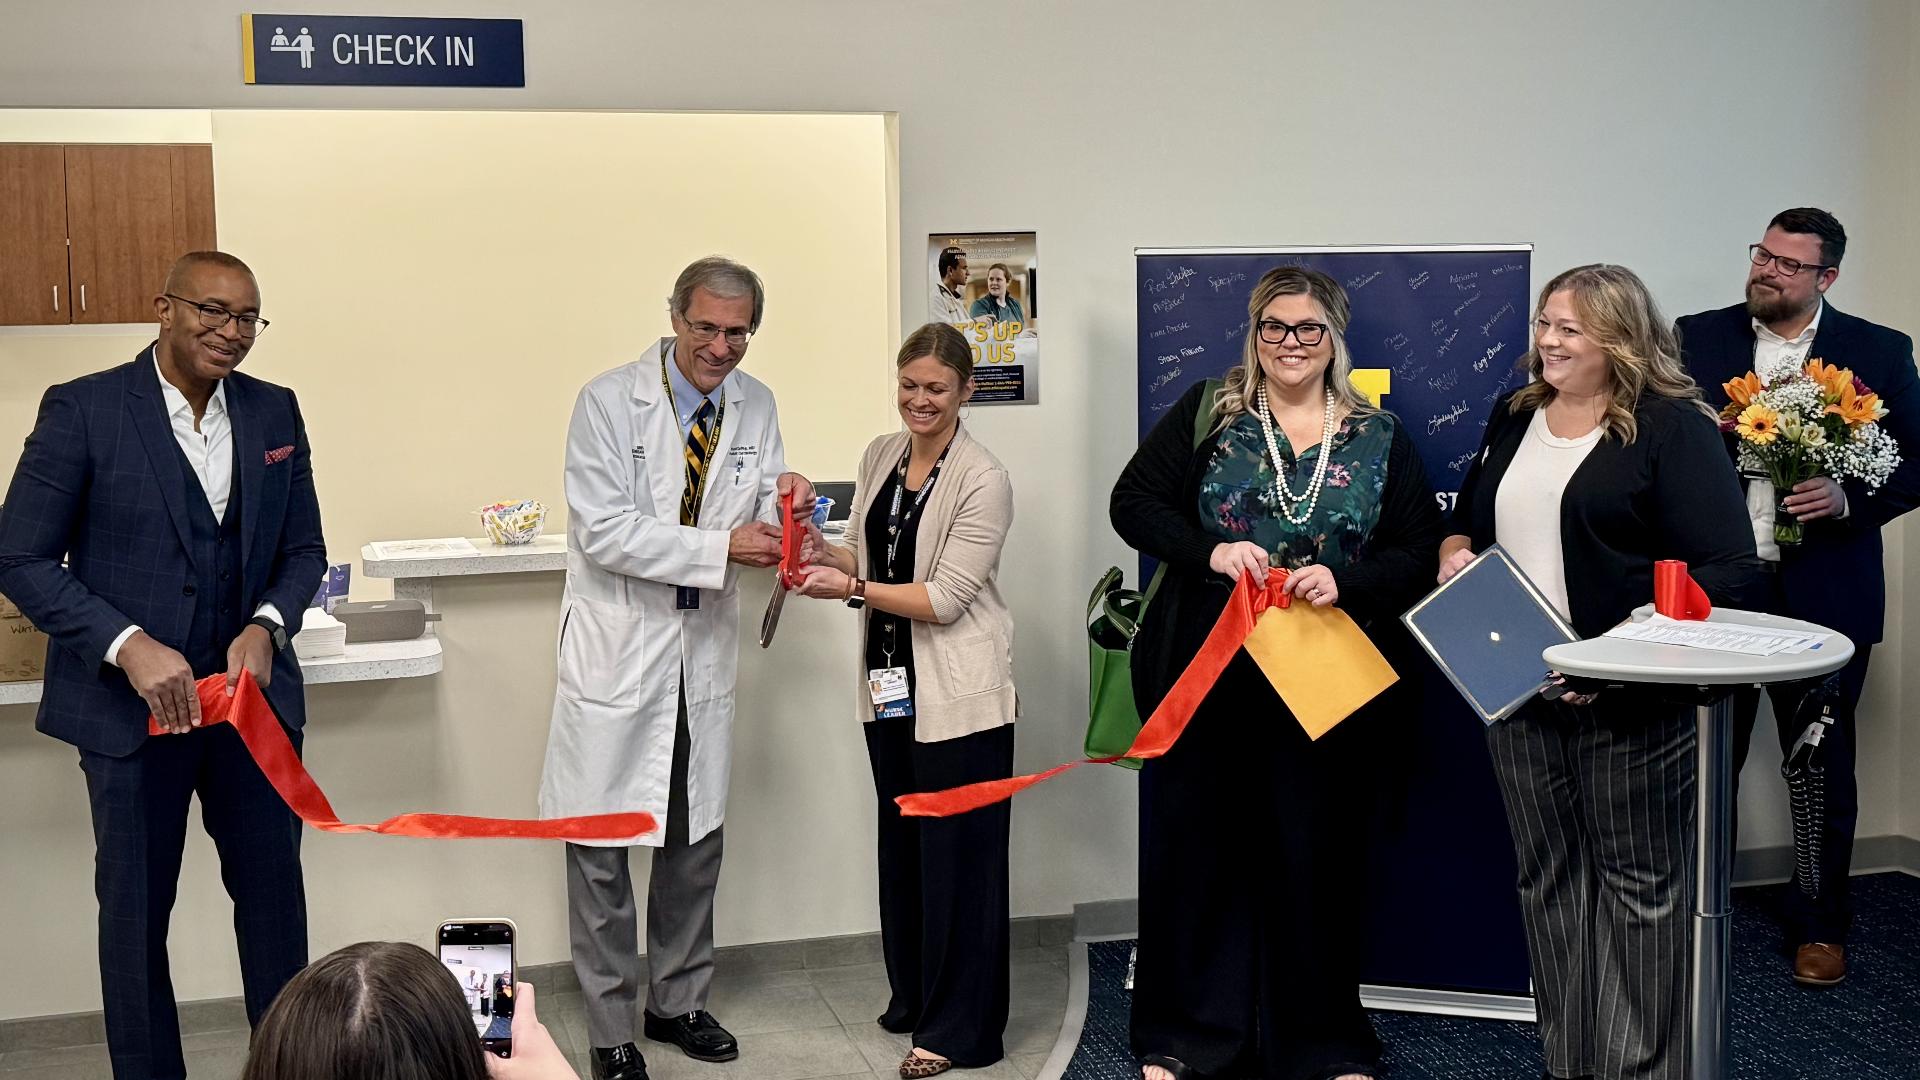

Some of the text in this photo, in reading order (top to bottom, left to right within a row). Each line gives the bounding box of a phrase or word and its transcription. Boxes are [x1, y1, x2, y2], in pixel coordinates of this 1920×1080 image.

[332, 33, 475, 67] CHECK IN
[953, 321, 1023, 343] T'S UP
[987, 342, 1016, 364] US
[891, 484, 901, 516] PENGUINS
[1435, 491, 1459, 512] ST
[11, 624, 39, 634] WAT
